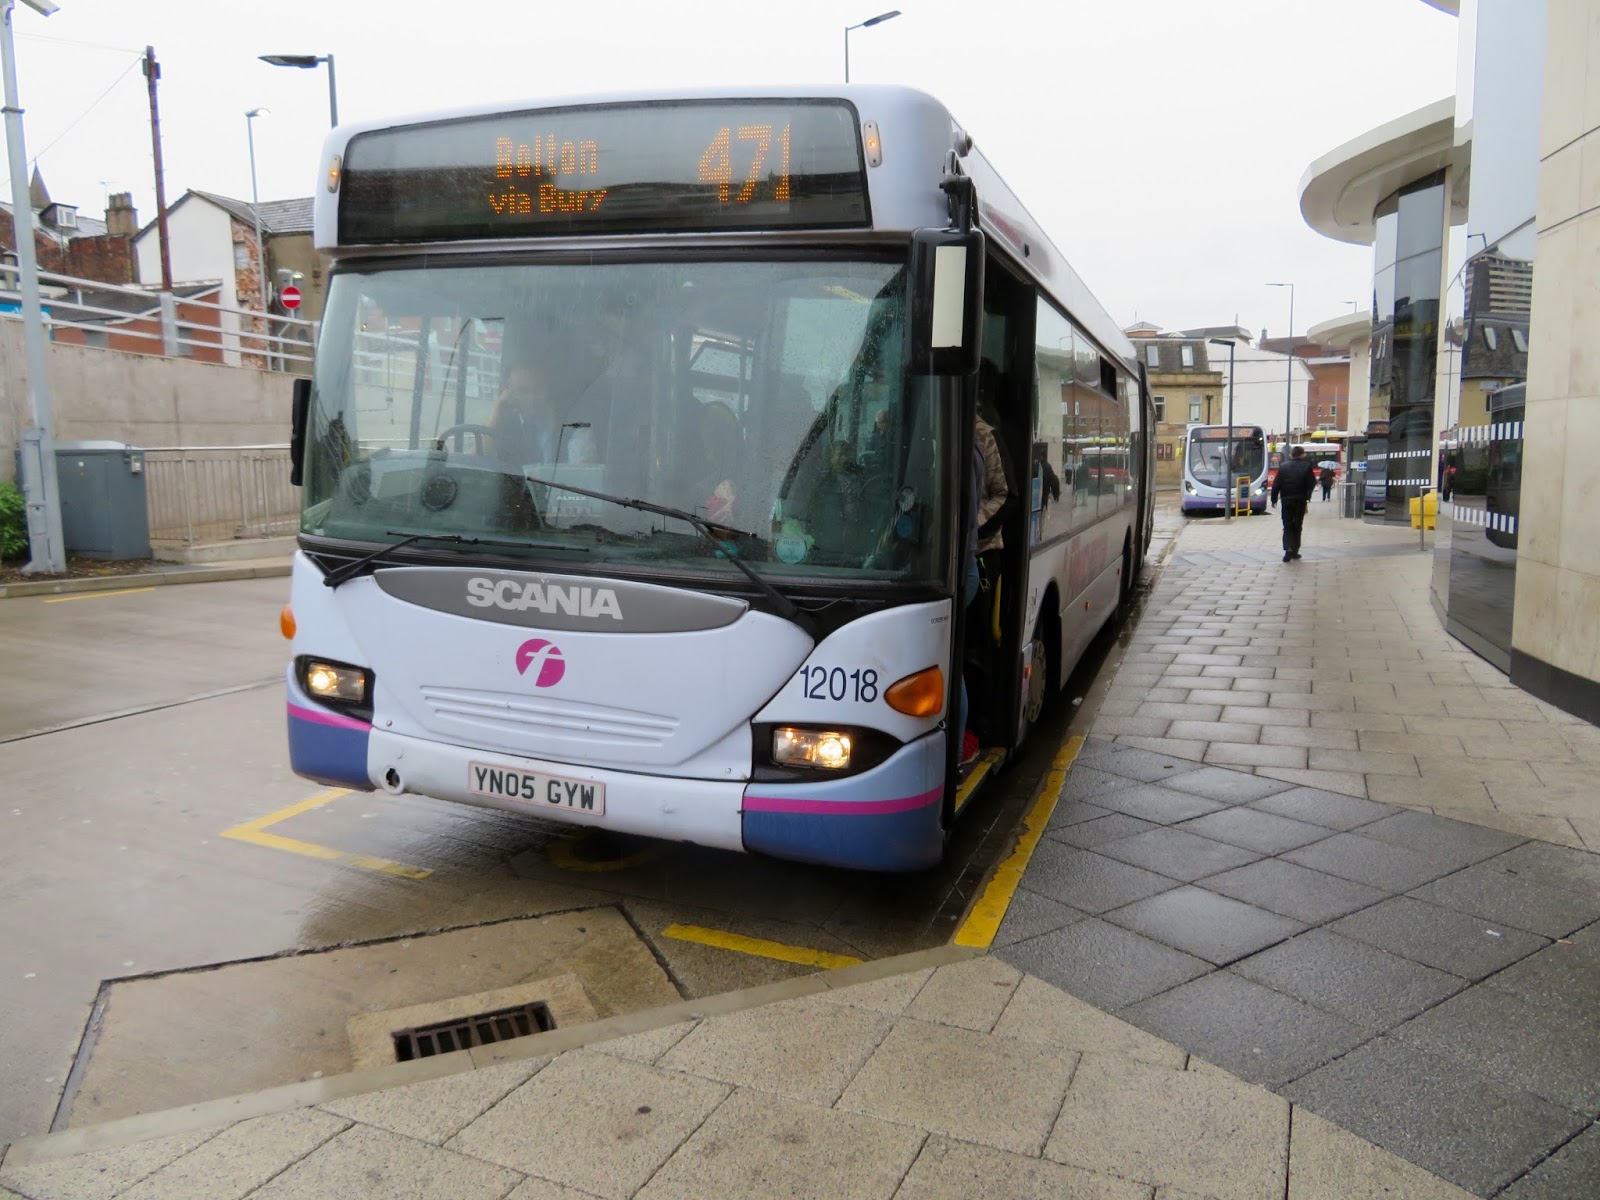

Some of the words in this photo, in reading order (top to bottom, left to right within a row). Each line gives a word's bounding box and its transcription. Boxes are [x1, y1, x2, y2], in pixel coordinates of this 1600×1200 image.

[495, 133, 598, 179] Bolton
[698, 123, 792, 202] 471
[489, 186, 532, 214] via
[539, 185, 608, 213] Bury
[466, 577, 623, 620] SCANIA
[800, 665, 877, 702] 12018
[474, 767, 534, 800] YN05
[547, 780, 595, 810] GYW
